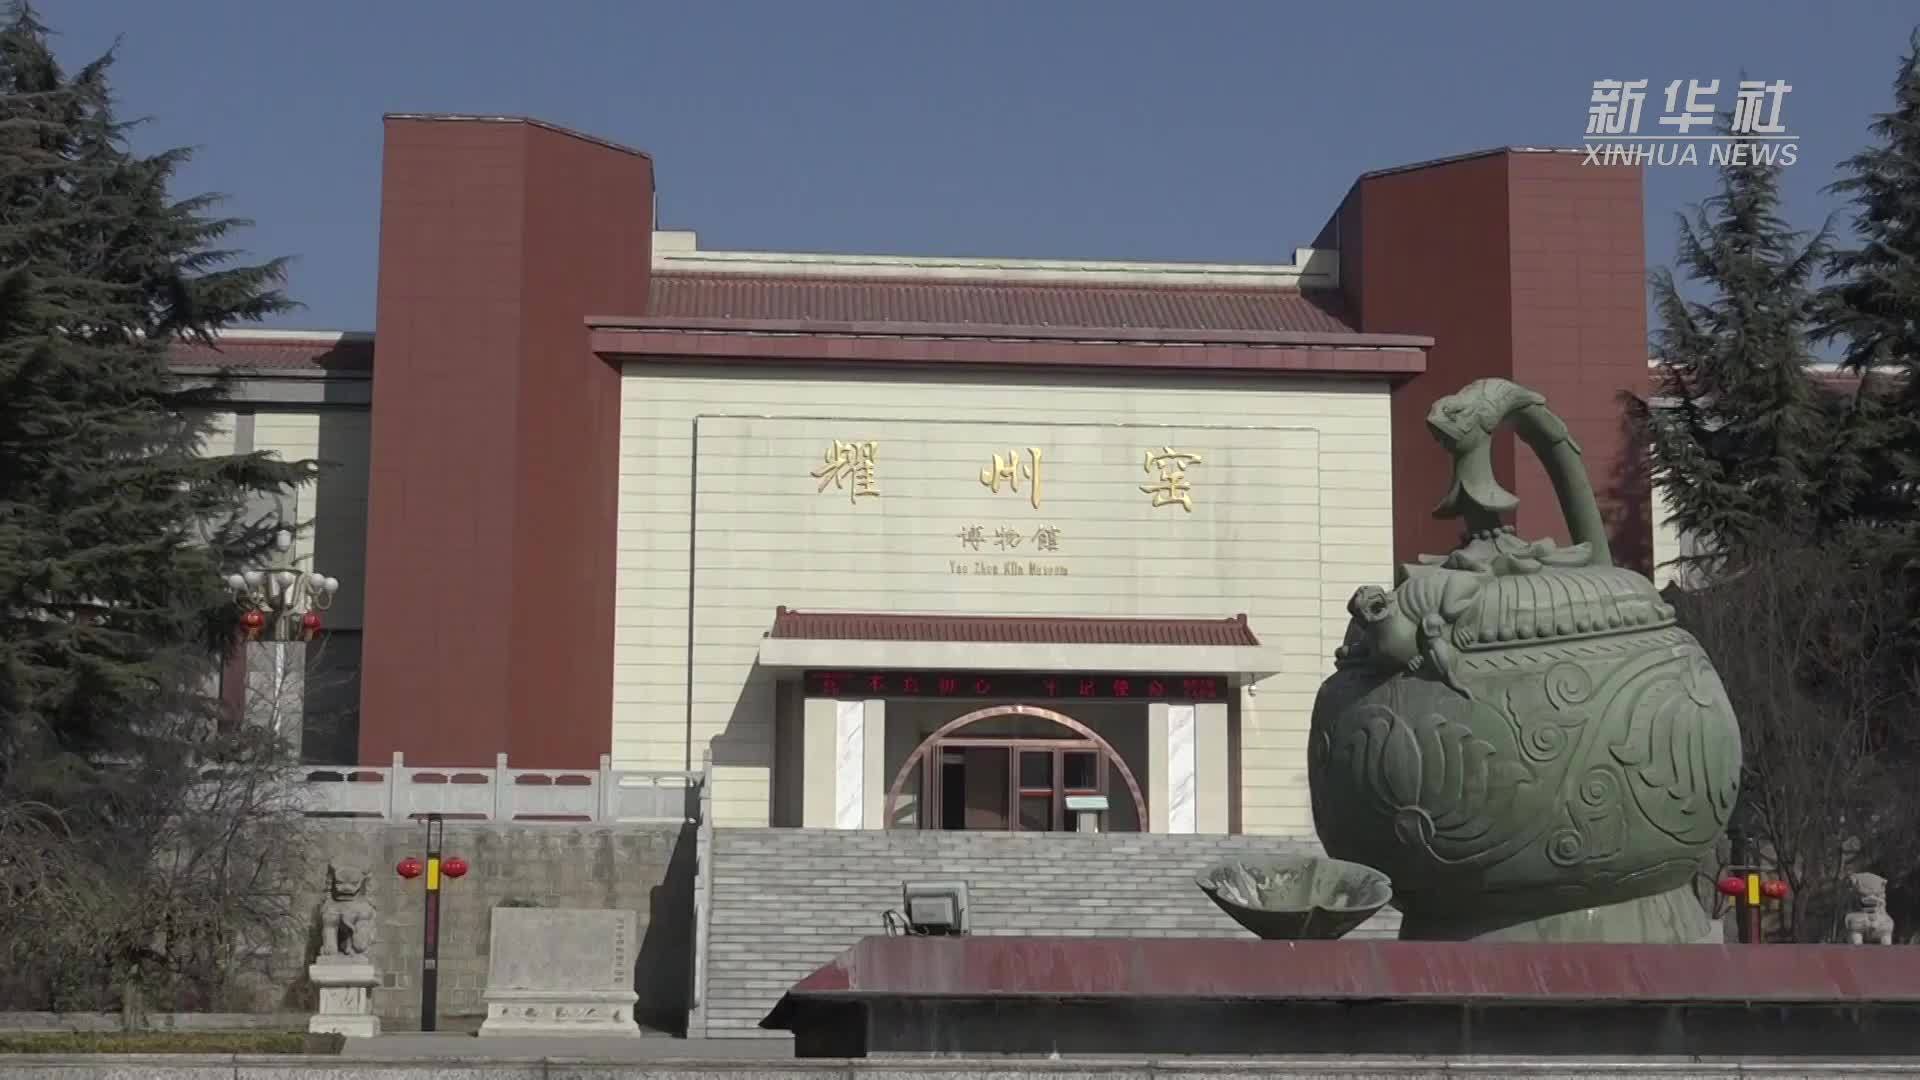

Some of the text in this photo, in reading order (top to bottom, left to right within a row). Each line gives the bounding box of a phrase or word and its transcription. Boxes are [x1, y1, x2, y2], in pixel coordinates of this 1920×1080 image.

[810, 439, 1202, 512] 耀州窑
[1028, 560, 1069, 576] Museum
